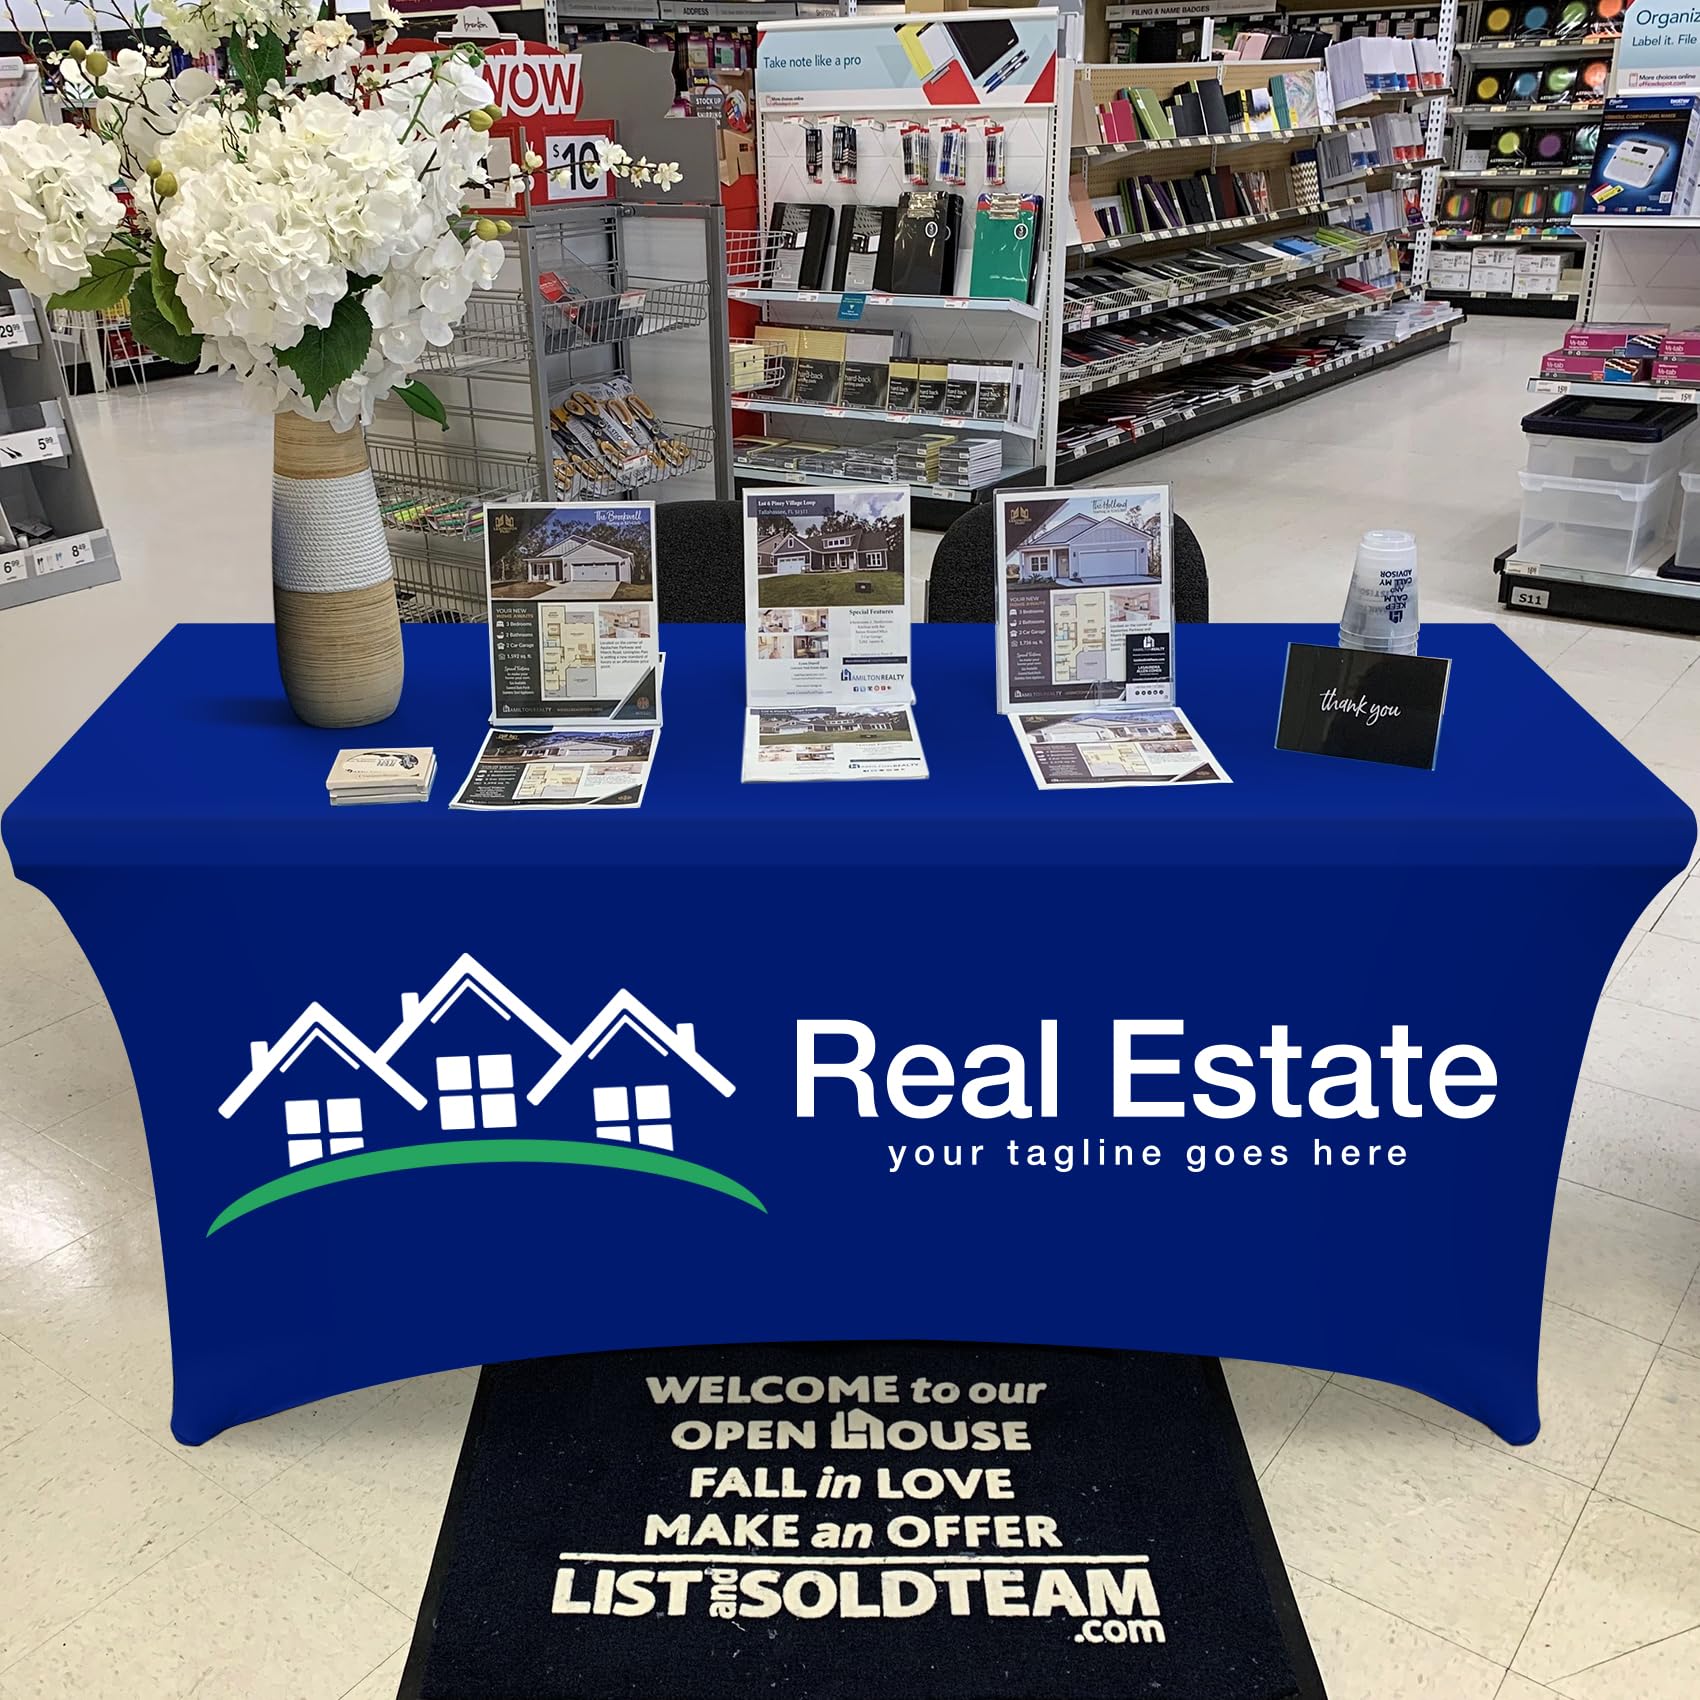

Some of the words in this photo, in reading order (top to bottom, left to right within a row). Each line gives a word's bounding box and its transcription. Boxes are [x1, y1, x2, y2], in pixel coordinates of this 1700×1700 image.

[683, 7, 709, 16] ADDRESS
[1131, 8, 1153, 16] FILING
[1182, 5, 1210, 13] BADGES
[1632, 35, 1661, 47] Label
[1664, 35, 1674, 46] it.
[1677, 34, 1697, 45] File
[763, 56, 787, 69] Take
[789, 56, 812, 68] note
[814, 54, 832, 67] like
[835, 57, 841, 66] a
[843, 55, 862, 69] pro
[1678, 72, 1696, 80] online
[696, 97, 714, 105] STOCK
[1380, 569, 1412, 578] ADVISOR
[1379, 578, 1393, 586] MY
[1394, 577, 1413, 586] CALL
[1384, 594, 1408, 602] CALM
[1518, 593, 1542, 606] S11
[848, 608, 869, 616] Special
[1385, 602, 1406, 611] KEEP
[1319, 687, 1368, 717] thank
[1365, 705, 1401, 726] you
[797, 1020, 1058, 1120] Real
[1113, 1020, 1498, 1120] Estate
[887, 1144, 985, 1172] your
[1007, 1138, 1162, 1172] tagline
[1186, 1144, 1289, 1172] goes
[1314, 1138, 1407, 1166] here
[646, 1375, 900, 1404] WELCOME
[910, 1377, 960, 1404] to
[969, 1382, 1047, 1404] our
[671, 1420, 816, 1450] OPEN
[690, 1467, 807, 1498] FALL
[815, 1465, 862, 1499] in
[877, 1468, 1015, 1500] LOVE
[644, 1513, 800, 1548] MAKE
[810, 1522, 874, 1549] an
[886, 1515, 1063, 1548] OFFER
[1074, 1619, 1166, 1644] .com
